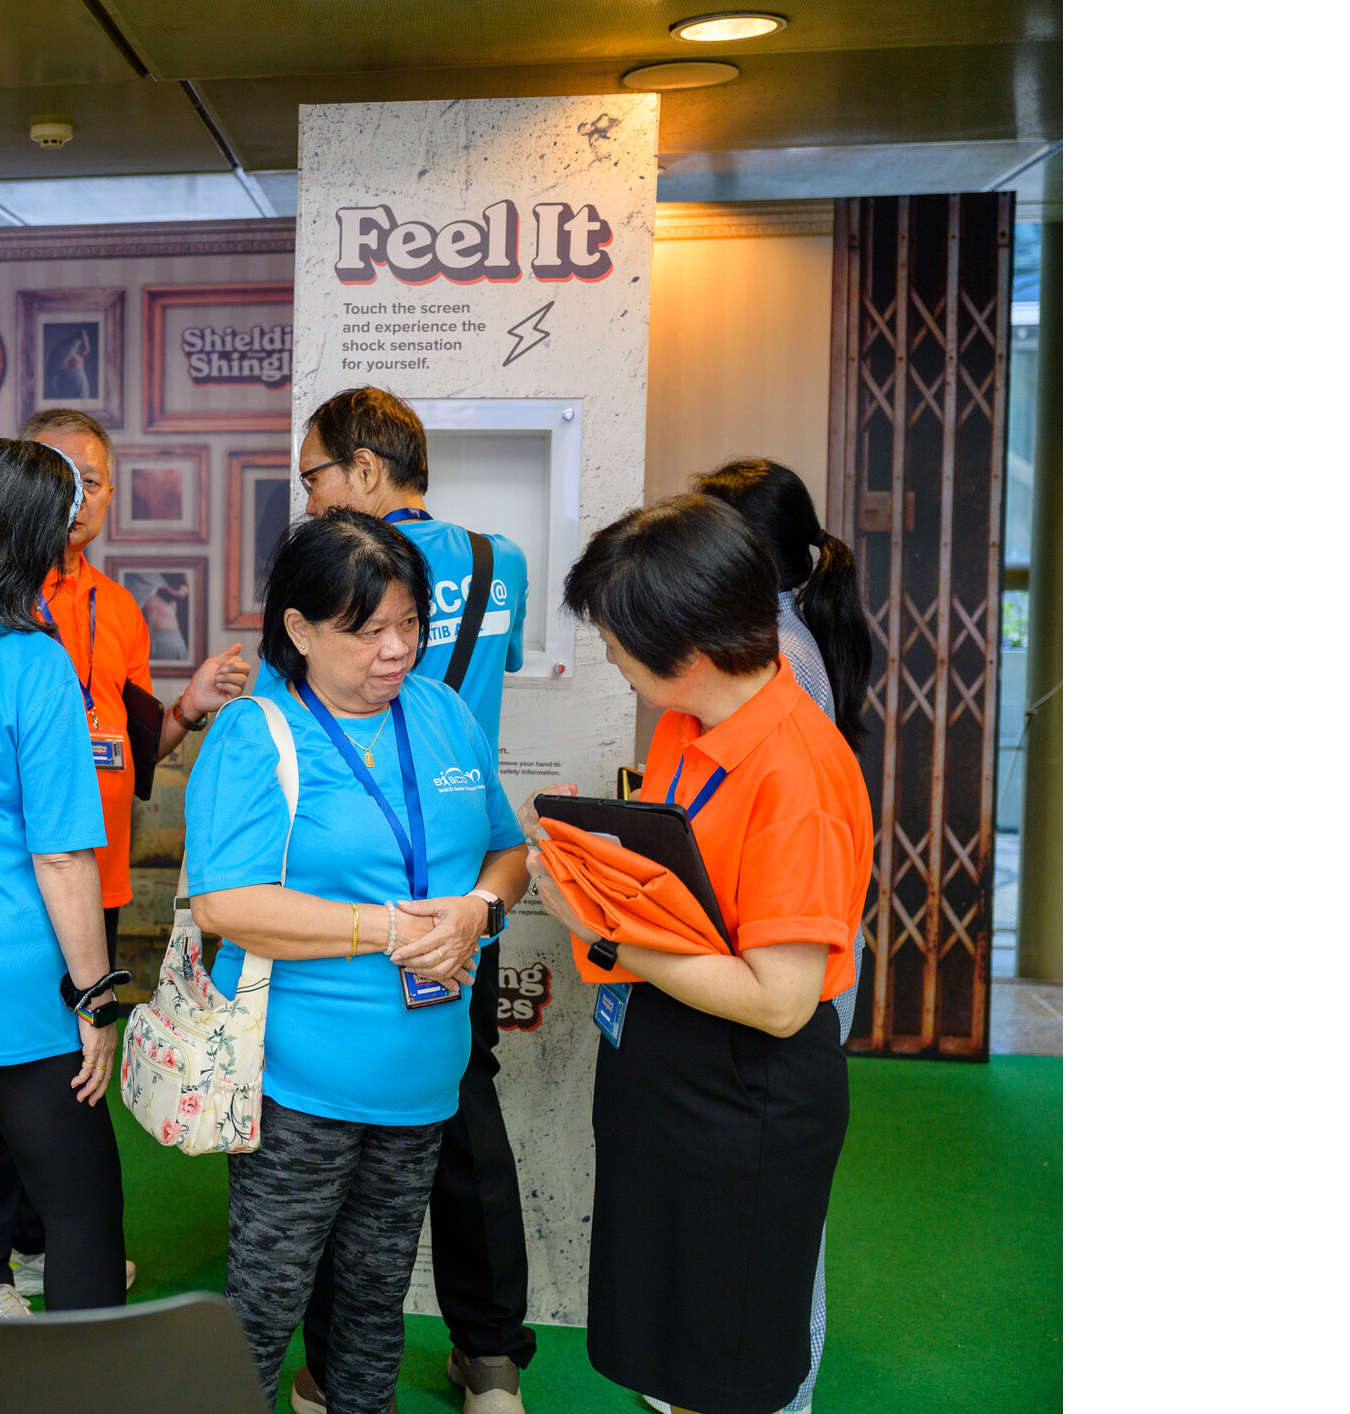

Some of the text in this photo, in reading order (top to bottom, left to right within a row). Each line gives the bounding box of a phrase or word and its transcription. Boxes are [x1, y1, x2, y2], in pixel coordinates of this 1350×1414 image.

[335, 200, 613, 285] Feel It
[343, 302, 471, 315] Touch the screen
[342, 319, 487, 337] and experience the
[342, 338, 463, 352] shock sensation
[342, 356, 430, 374] for yourself.
